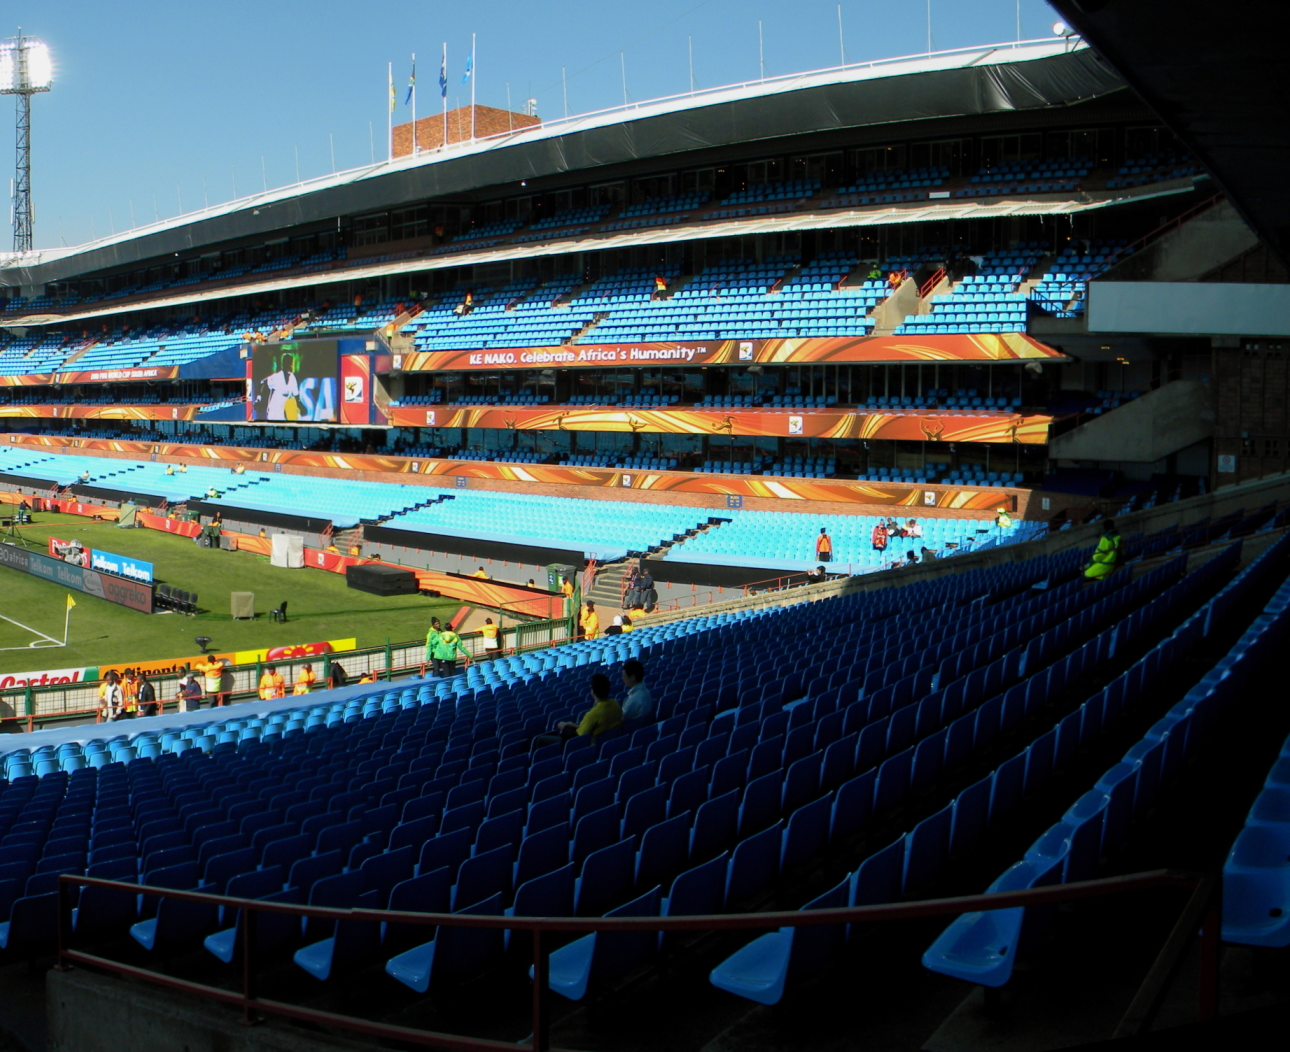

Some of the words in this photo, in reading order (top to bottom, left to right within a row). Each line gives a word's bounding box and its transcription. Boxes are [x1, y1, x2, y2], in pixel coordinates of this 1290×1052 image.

[469, 354, 482, 365] KE
[484, 353, 517, 364] NAKO.
[520, 351, 575, 363] Celebrate
[577, 348, 627, 361] Africa's
[10, 553, 28, 567] africa
[31, 558, 53, 577] Telkom
[57, 566, 82, 586] Telkom
[122, 562, 151, 582] Telkom
[108, 582, 147, 606] aggreko
